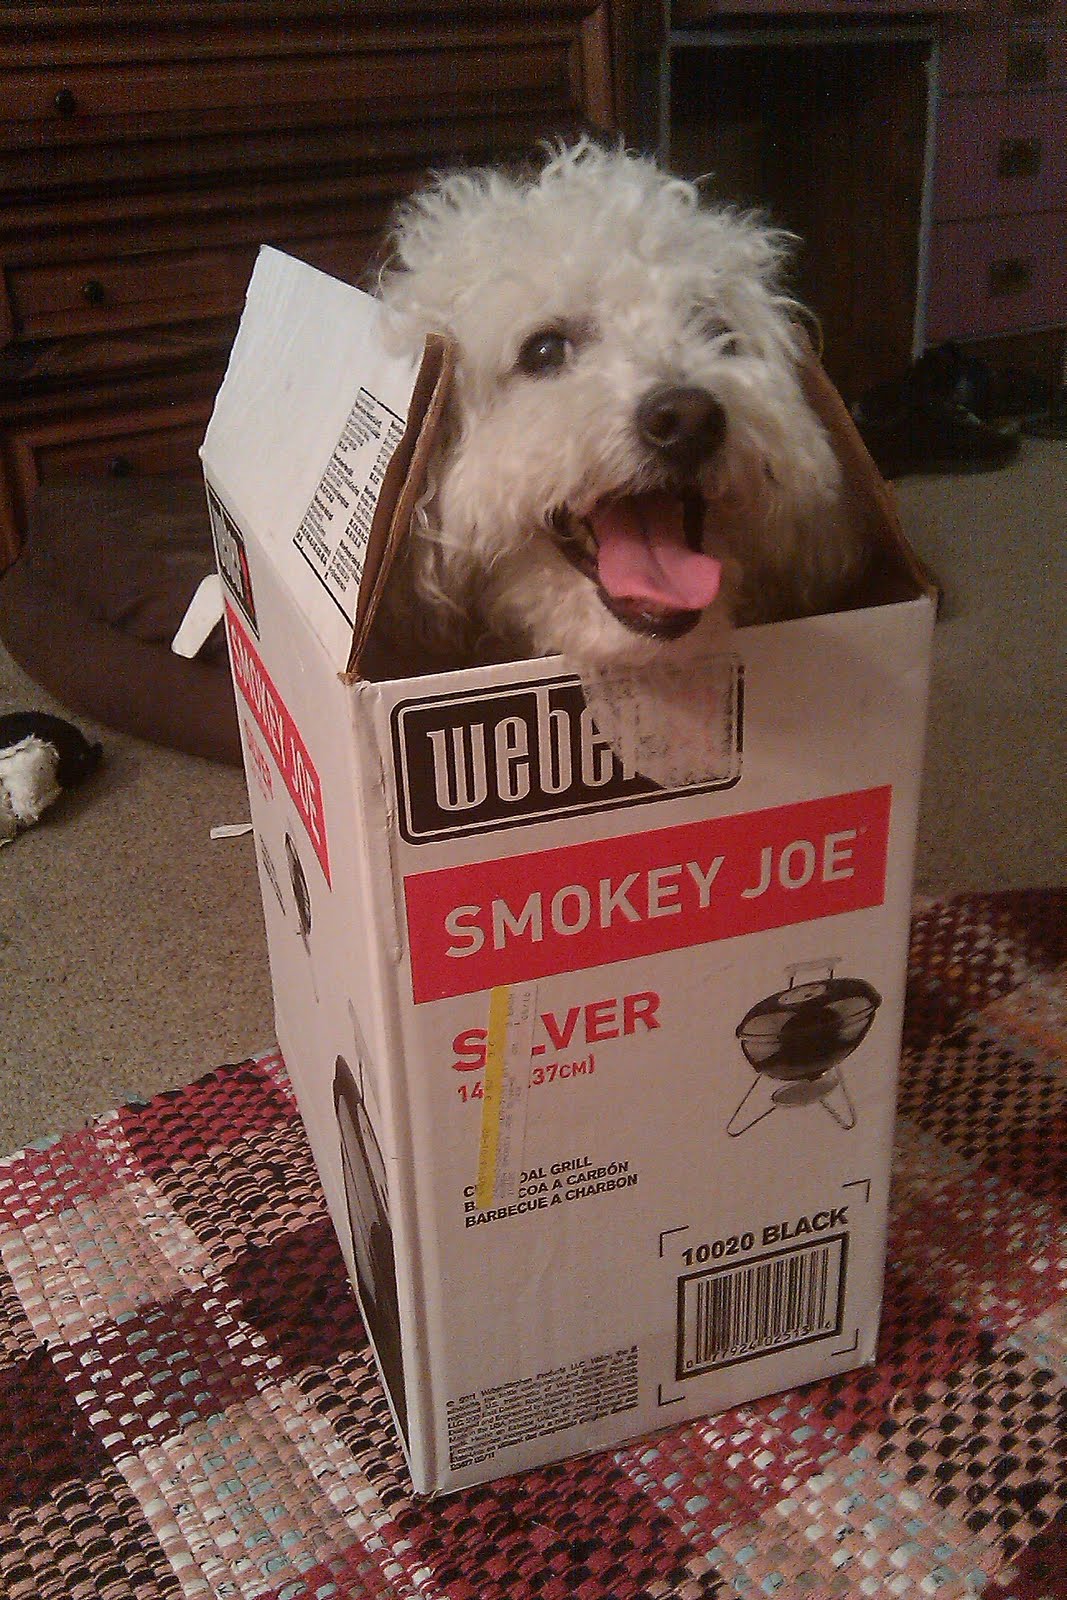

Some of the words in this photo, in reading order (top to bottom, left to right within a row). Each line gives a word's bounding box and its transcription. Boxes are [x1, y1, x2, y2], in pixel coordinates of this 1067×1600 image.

[426, 683, 637, 812] webe
[444, 855, 727, 959] SMOKEY
[741, 828, 858, 899] JOE
[451, 991, 661, 1073] SVER
[550, 1156, 593, 1176] GRILL
[551, 1178, 563, 1191] A
[566, 1161, 629, 1186] CARBÓN
[465, 1197, 549, 1229] BARBECUE
[550, 1193, 563, 1206] A
[565, 1173, 638, 1201] CHARBON
[682, 1231, 755, 1266] 10020
[762, 1206, 849, 1246] BLACK
